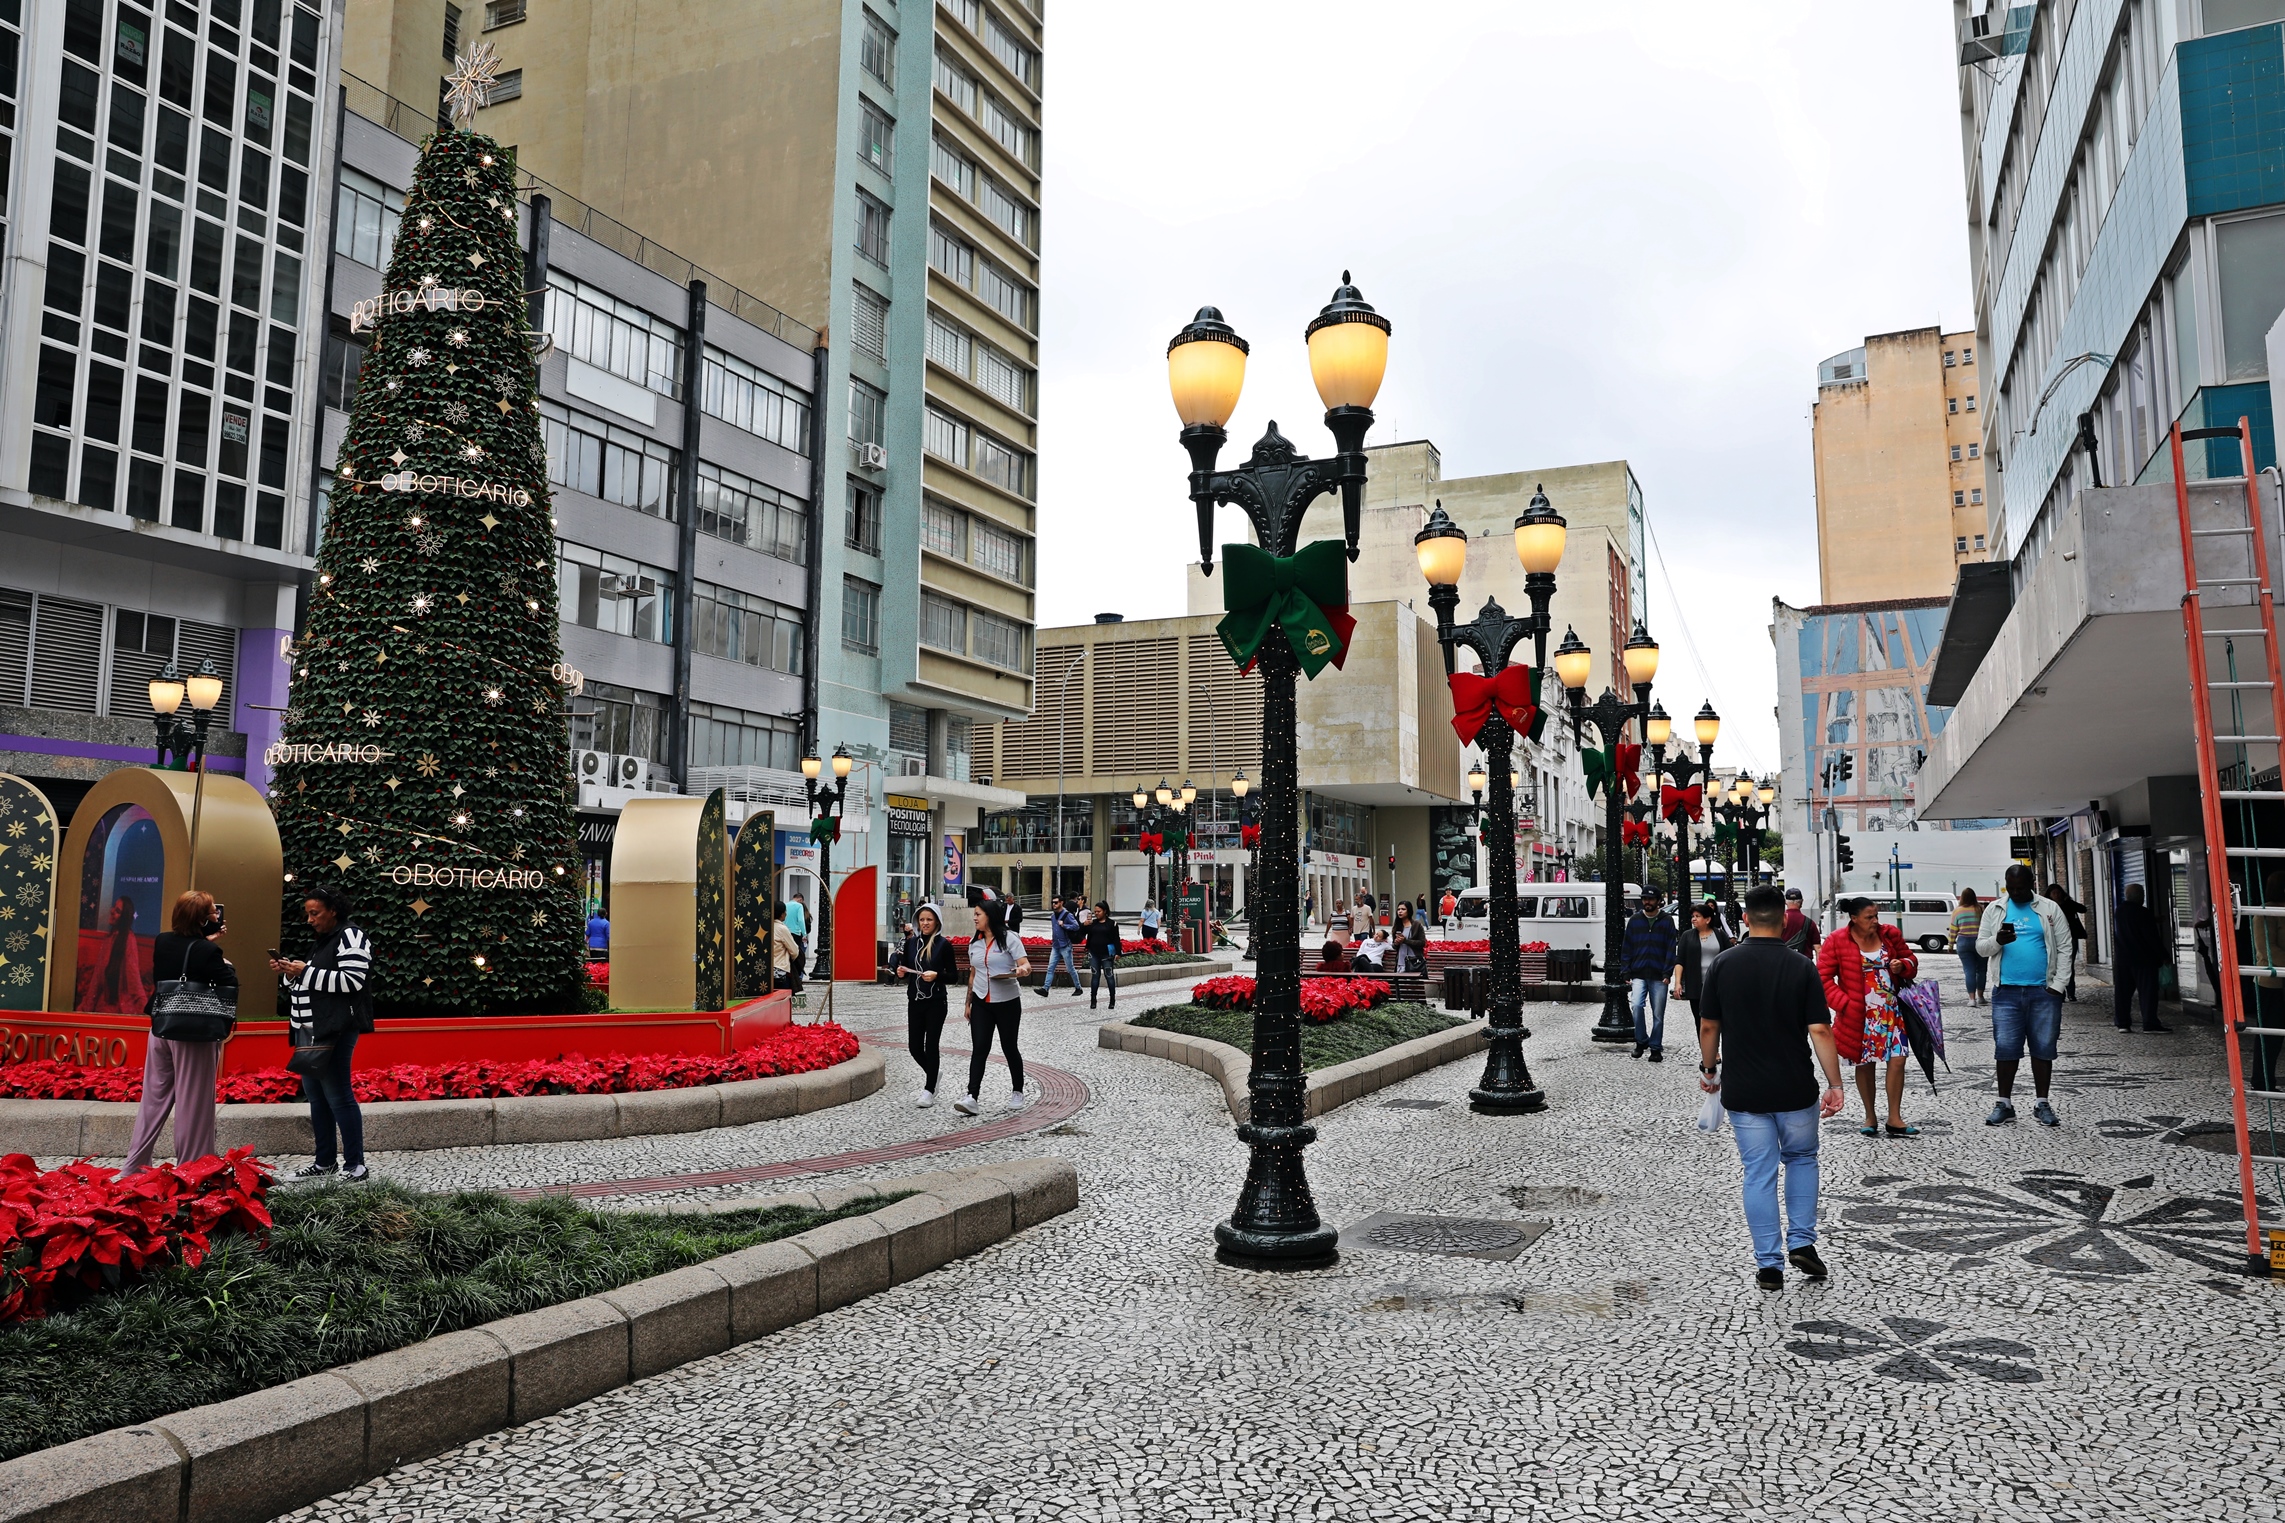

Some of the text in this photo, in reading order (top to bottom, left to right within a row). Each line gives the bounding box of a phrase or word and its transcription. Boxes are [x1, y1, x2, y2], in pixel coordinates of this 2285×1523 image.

[224, 412, 247, 428] VENDE
[897, 797, 920, 809] LOJA
[890, 808, 926, 822] POSITIVO
[890, 819, 926, 833] TECNOLOGIA
[1193, 851, 1215, 861] Pink
